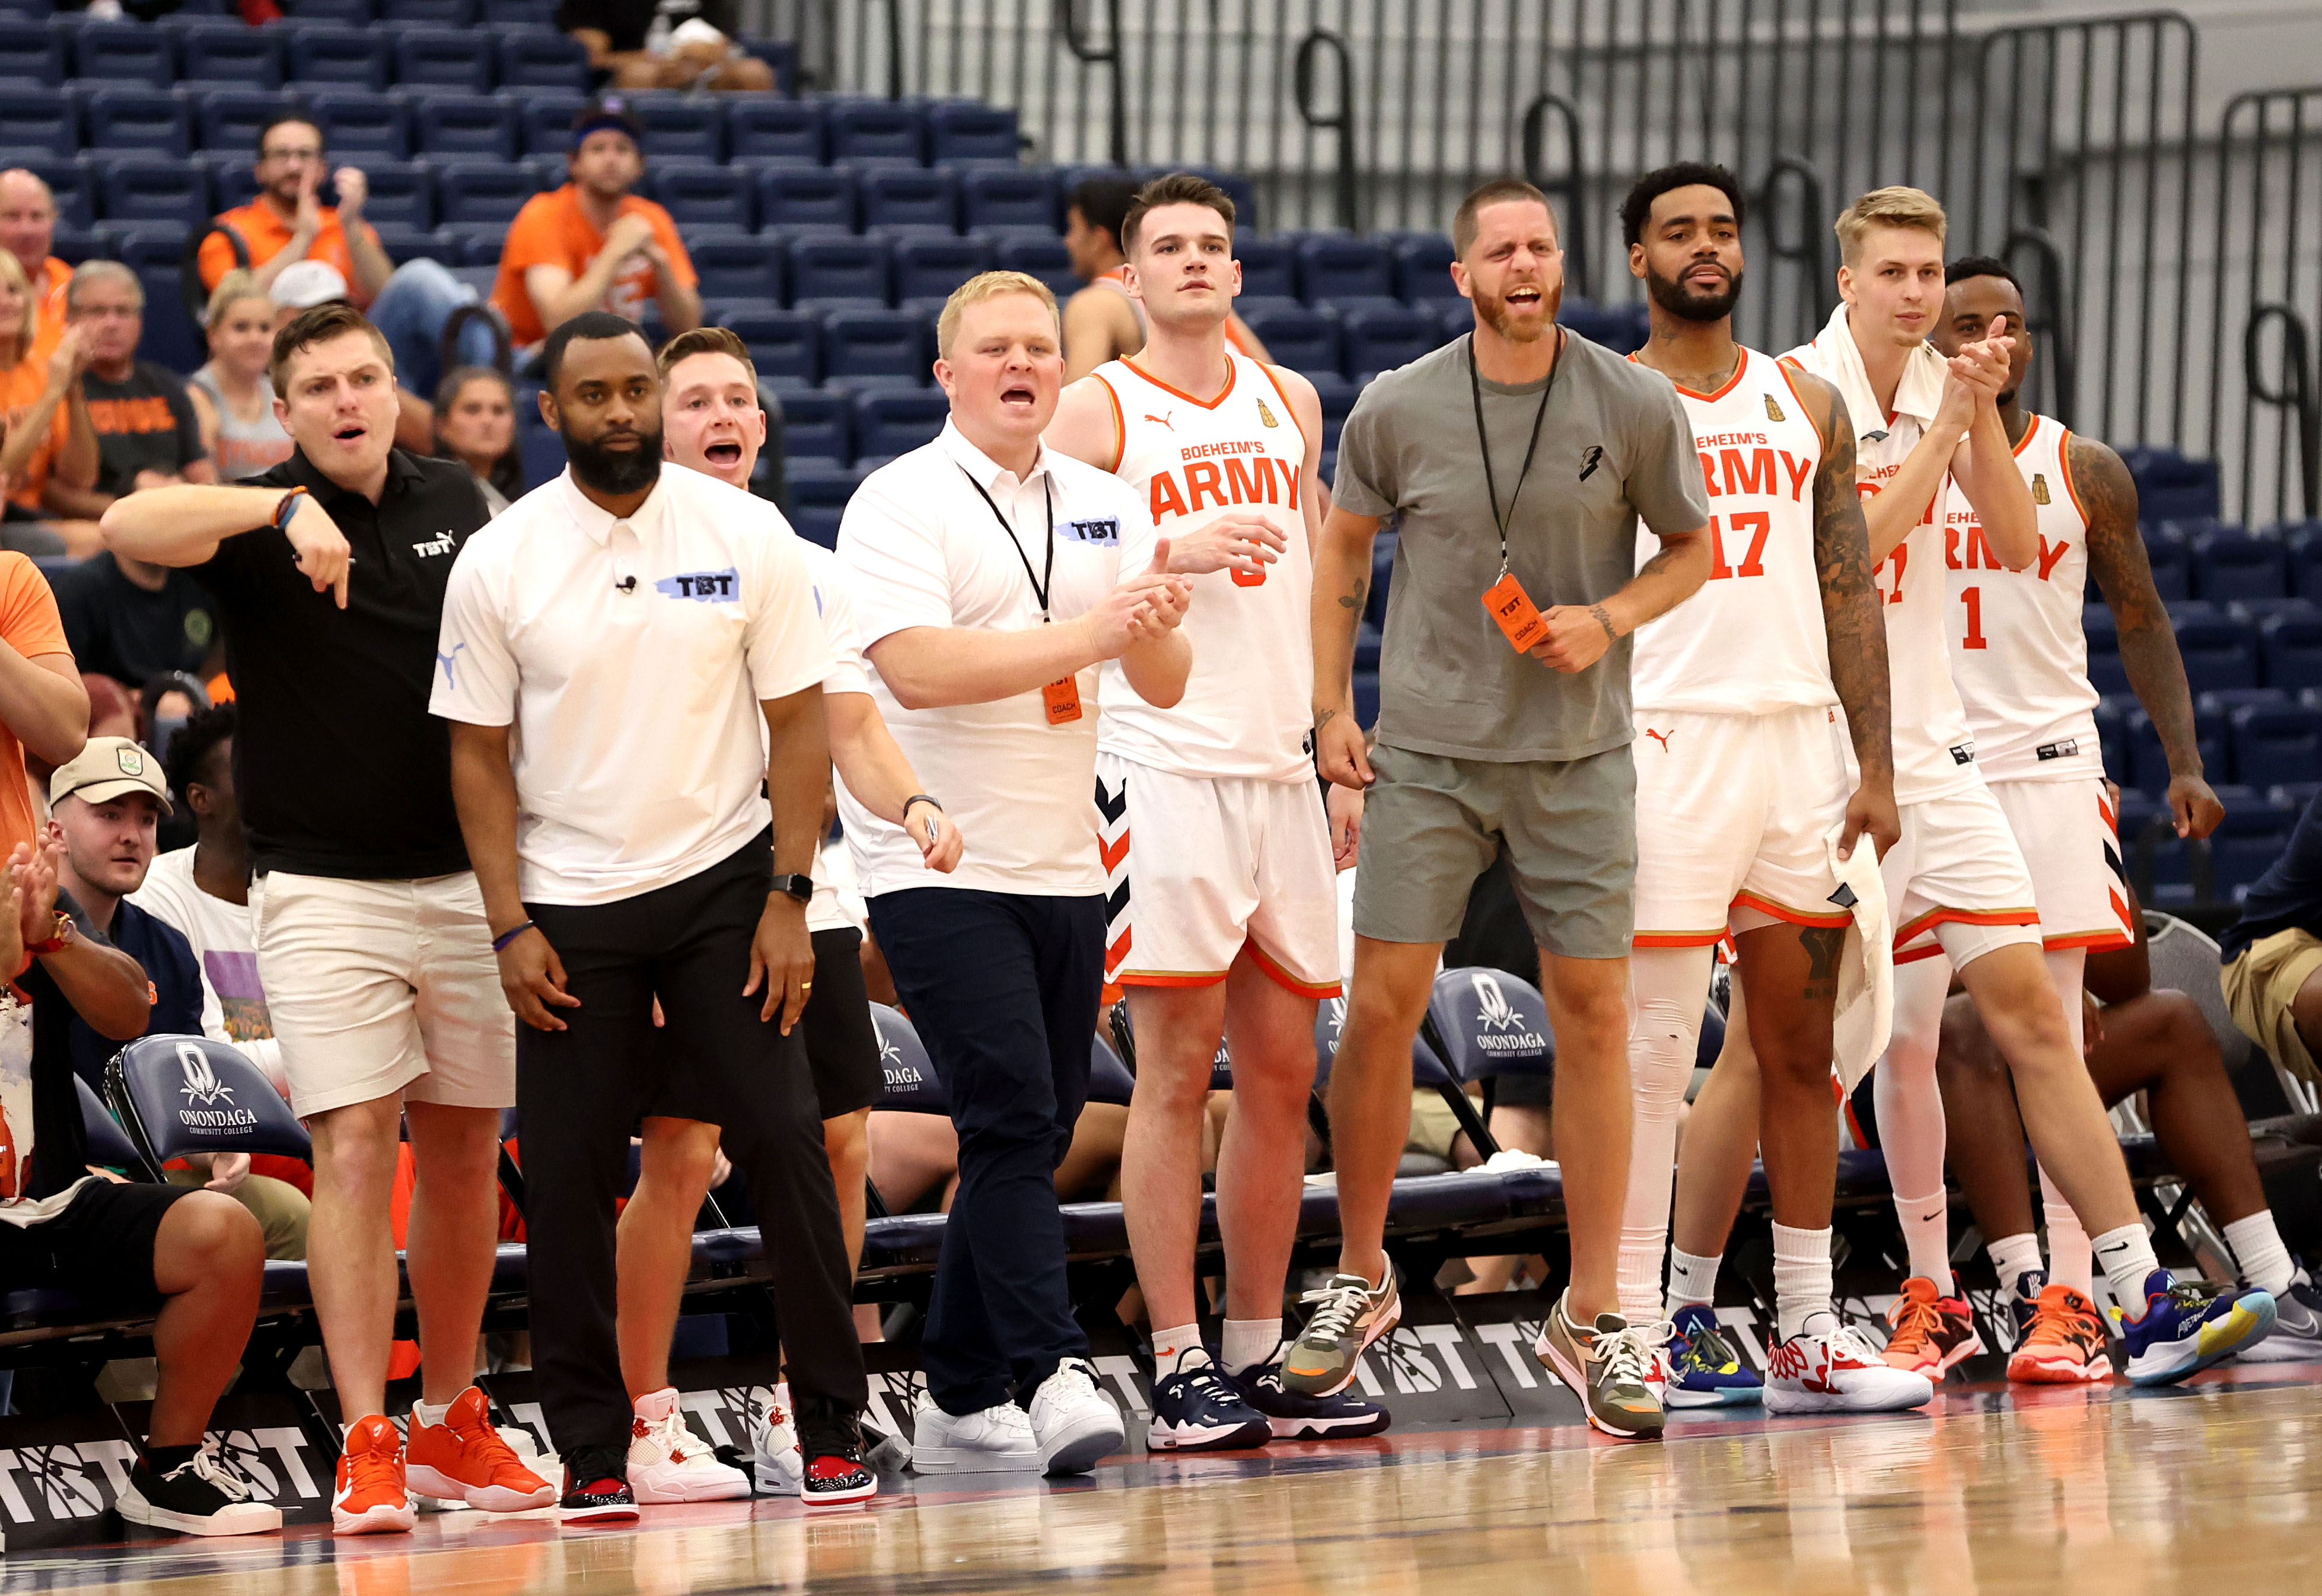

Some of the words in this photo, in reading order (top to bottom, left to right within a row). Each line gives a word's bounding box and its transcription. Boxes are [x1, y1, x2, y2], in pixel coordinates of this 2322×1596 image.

[1696, 432, 1768, 448] EHEIM'S
[1180, 441, 1266, 461] BOEHEIM'S
[1698, 448, 1812, 503] RMY
[1150, 457, 1299, 527] ARMY
[1071, 521, 1117, 540] TBT
[412, 539, 451, 558] TBT
[1708, 511, 1770, 581] 17
[1945, 527, 2071, 582] RMY
[676, 575, 732, 597] TBT
[1500, 597, 1521, 617] TBT
[1961, 587, 1987, 649] 1
[1514, 620, 1539, 641] COACH
[1052, 702, 1076, 714] COACH
[1476, 1032, 1546, 1050] ONONDAGA
[892, 1084, 919, 1092] COLLEGE
[179, 1108, 258, 1127] ONONDAGA
[189, 1127, 222, 1136] COMMUNITY
[223, 1126, 253, 1135] COLLEGE
